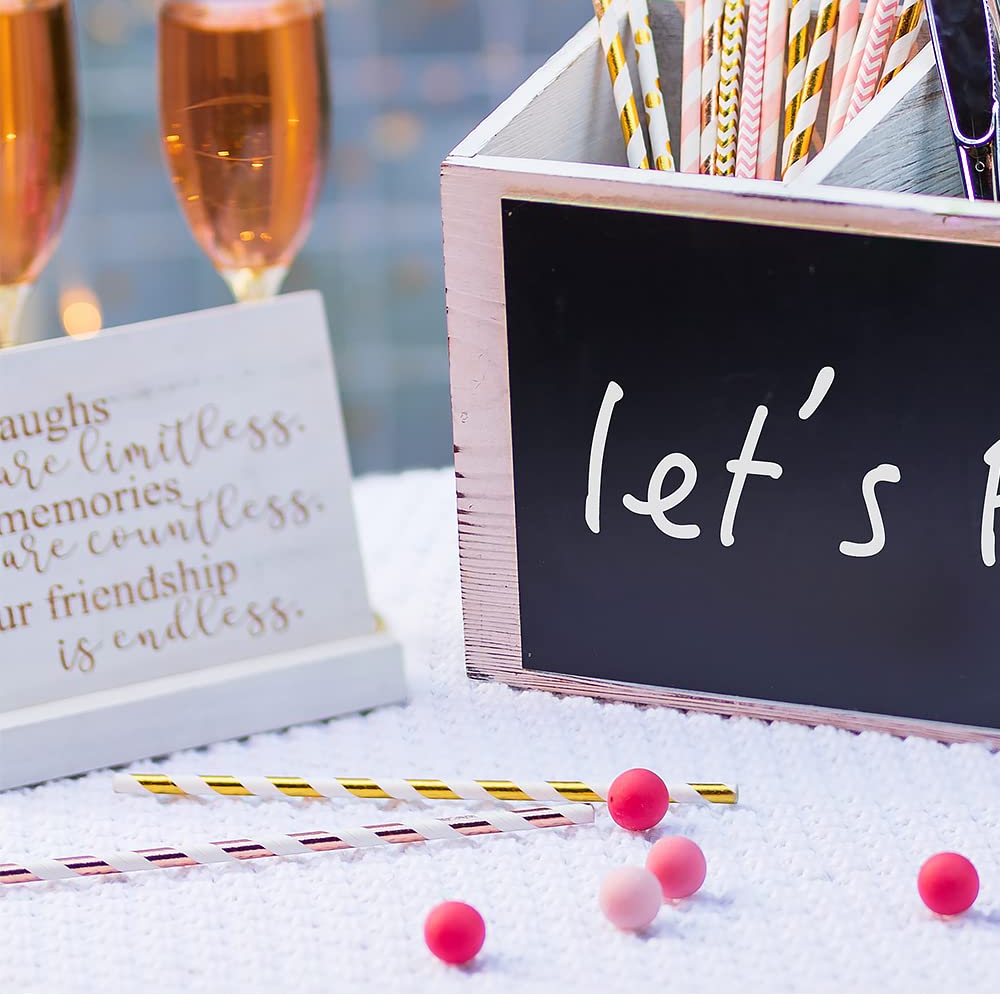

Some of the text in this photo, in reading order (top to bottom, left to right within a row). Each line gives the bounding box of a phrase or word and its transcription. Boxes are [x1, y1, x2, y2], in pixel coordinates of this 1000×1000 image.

[79, 403, 305, 475] limitless.
[584, 366, 901, 558] let's
[0, 475, 183, 535] memories
[2, 483, 325, 574] are countless.
[46, 554, 238, 620] friendship
[58, 596, 304, 673] is endless.
